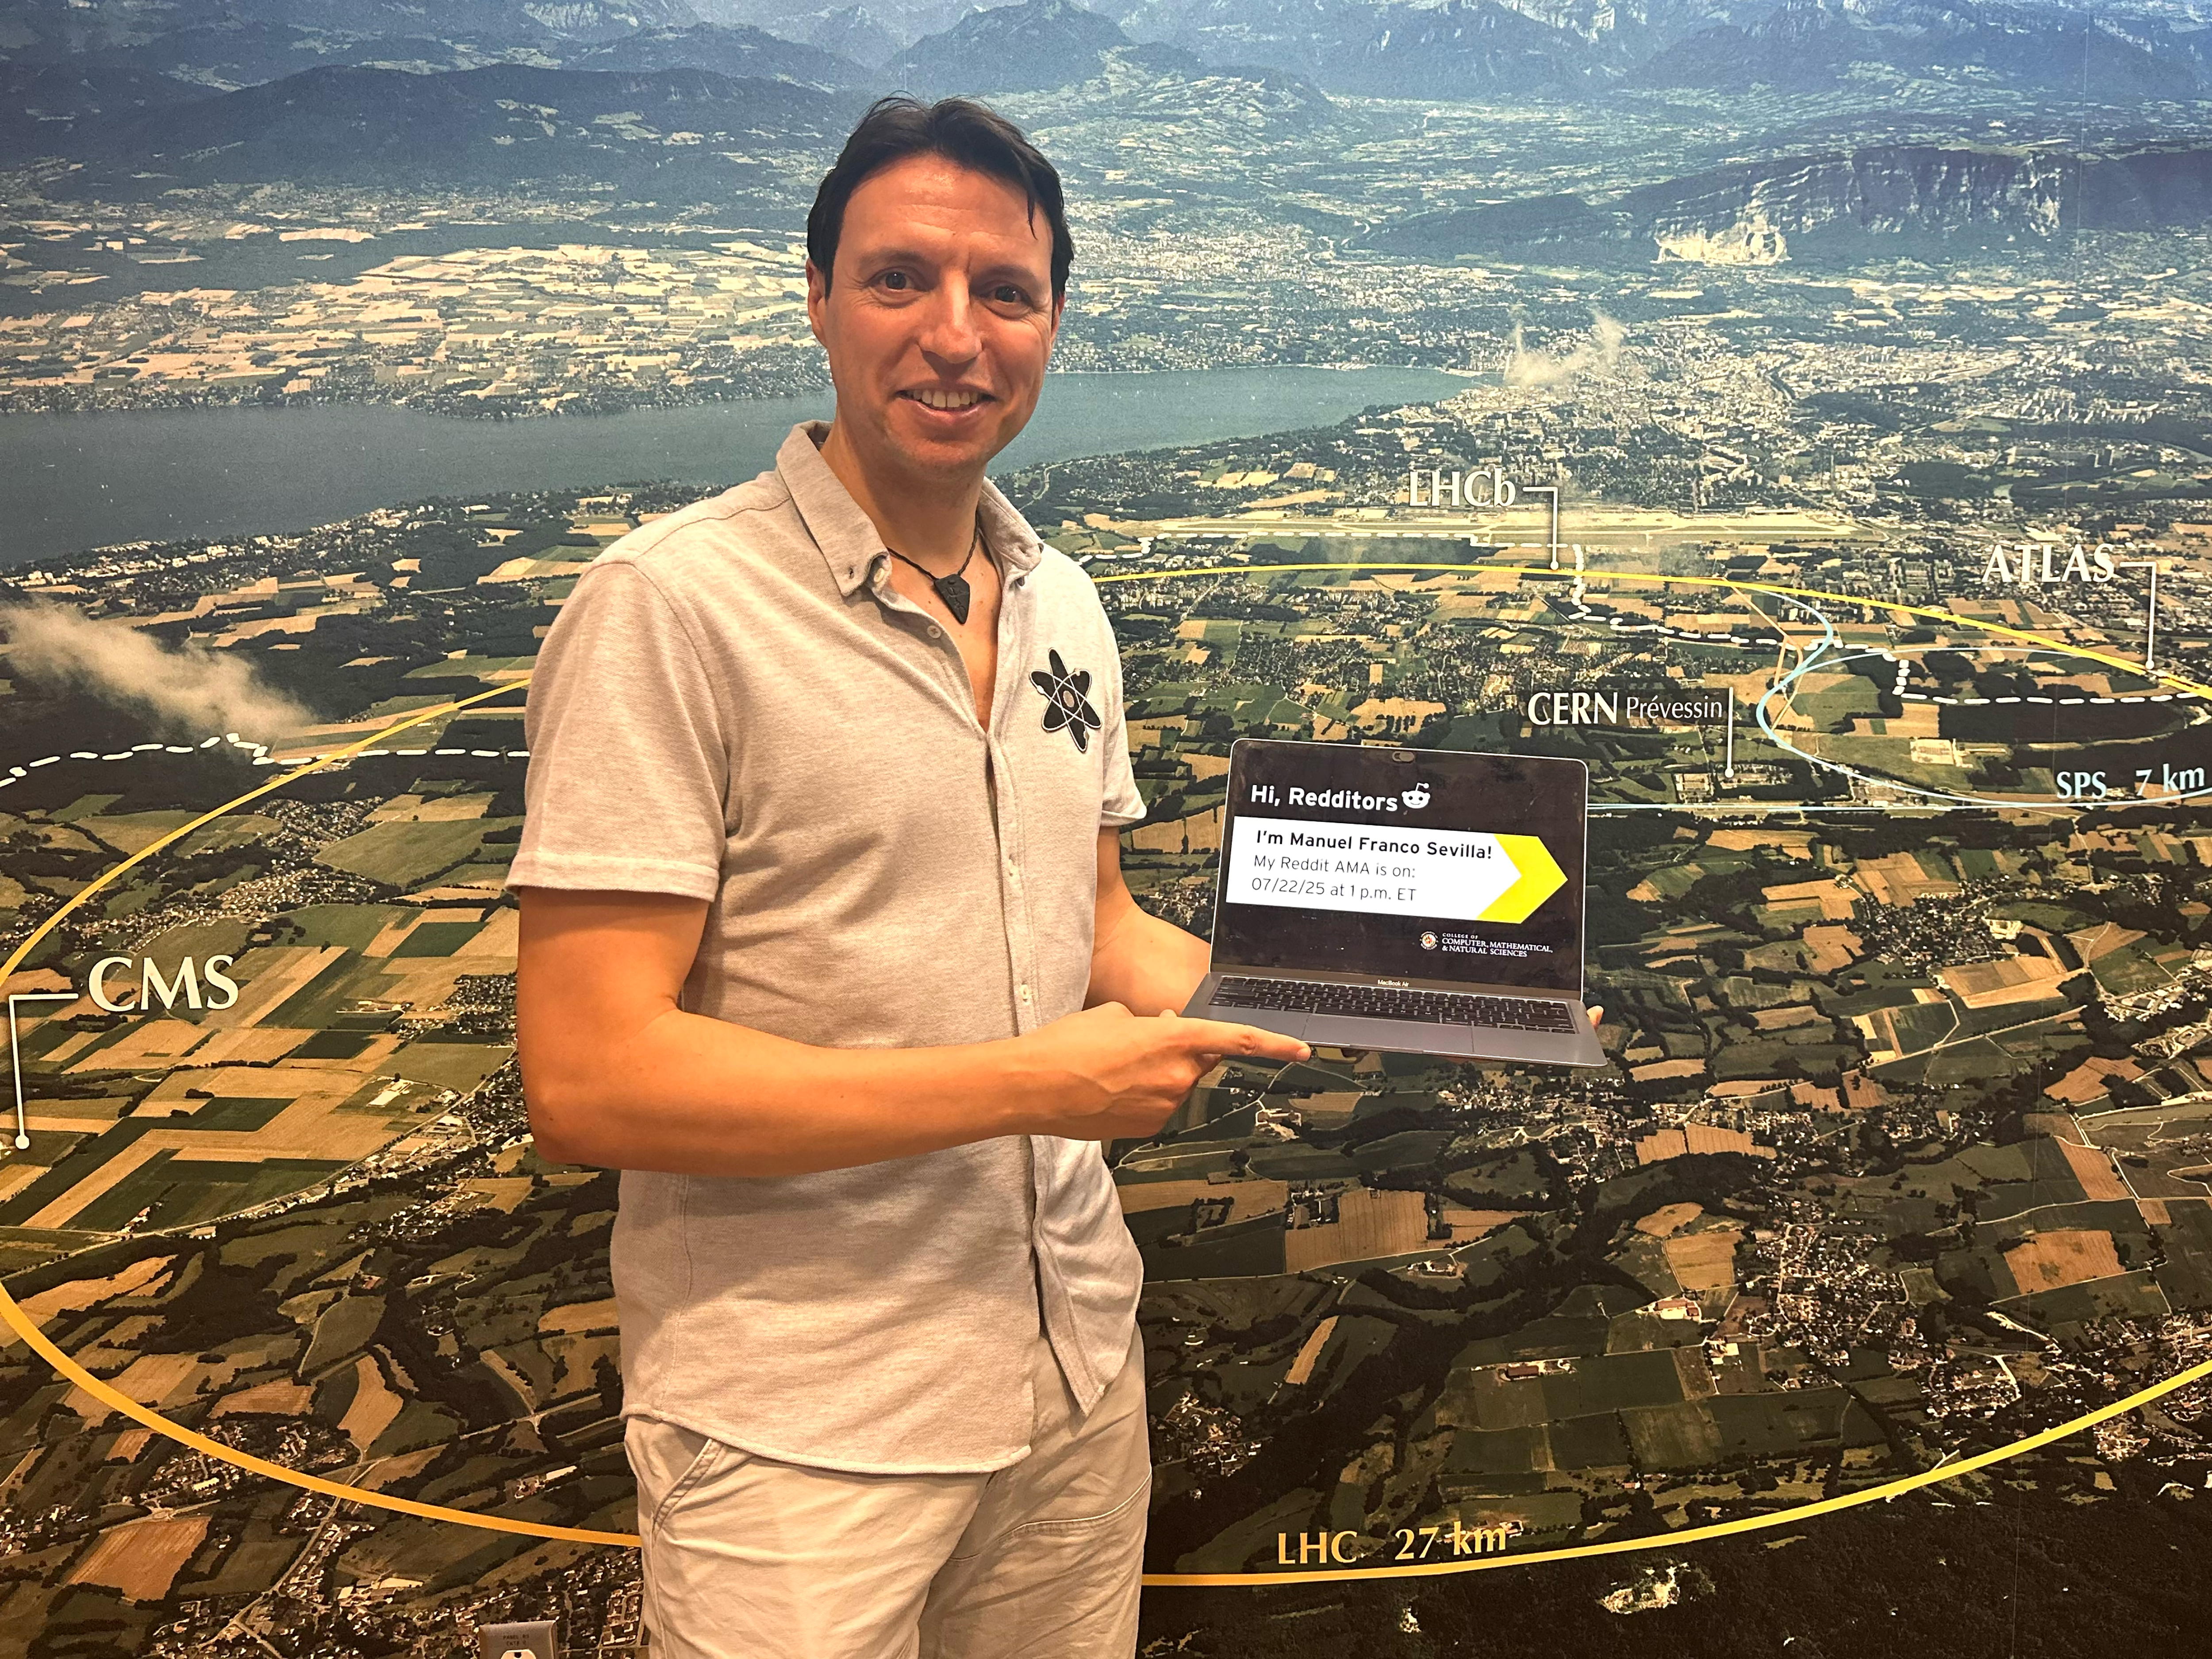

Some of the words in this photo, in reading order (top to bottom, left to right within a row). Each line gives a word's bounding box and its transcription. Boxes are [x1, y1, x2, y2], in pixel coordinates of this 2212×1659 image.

[1409, 467, 1516, 506] LHCb
[1982, 543, 2114, 582] ATLAS
[1528, 692, 1618, 725] CERN
[1627, 695, 1722, 719] Prévessin
[2057, 771, 2107, 799] SPS
[2135, 769, 2152, 796] 7
[2163, 763, 2204, 793] km
[1251, 785, 1280, 806] Hi,
[1289, 787, 1398, 812] Redditors
[1257, 830, 1283, 844] I'm
[1290, 832, 1352, 850] Manuel
[1359, 837, 1420, 854] Franco
[1427, 842, 1492, 859] Sevilla!
[1254, 854, 1275, 870] My
[1281, 857, 1329, 872] Reddit
[1335, 861, 1370, 875] AMA
[1376, 863, 1386, 876] is
[1392, 866, 1415, 878] on:
[1252, 877, 1325, 895] 07/22/25
[1330, 884, 1344, 897] at
[1351, 885, 1355, 897] 1
[1360, 888, 1392, 900] p.m.
[1398, 888, 1417, 901] ET
[1442, 938, 1489, 948] COMPUTER,
[1490, 941, 1553, 953] MATHEMATICAL,
[1449, 945, 1487, 954] NATURAL
[1490, 948, 1528, 957] SCIENCES
[89, 955, 238, 1011] CMS
[1278, 1530, 1358, 1564] LHC
[1394, 1527, 1440, 1560] 27
[1453, 1521, 1506, 1555] km
